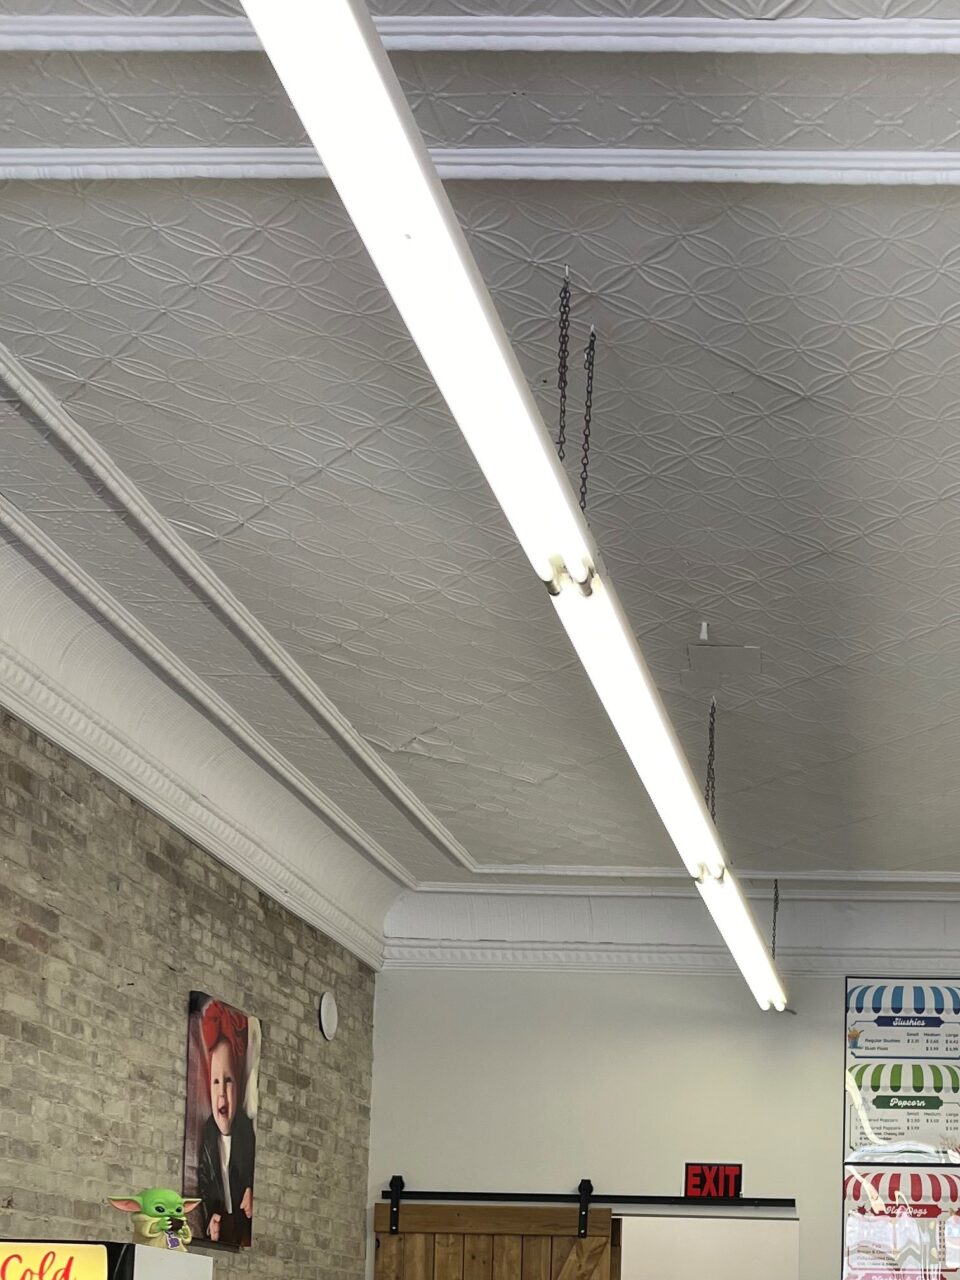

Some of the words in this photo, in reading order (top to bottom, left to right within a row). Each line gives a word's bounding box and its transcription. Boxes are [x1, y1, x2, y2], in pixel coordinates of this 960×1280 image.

[892, 1017, 926, 1027] Slushies
[889, 1097, 926, 1108] Popcorn
[687, 1165, 740, 1197] EXIT
